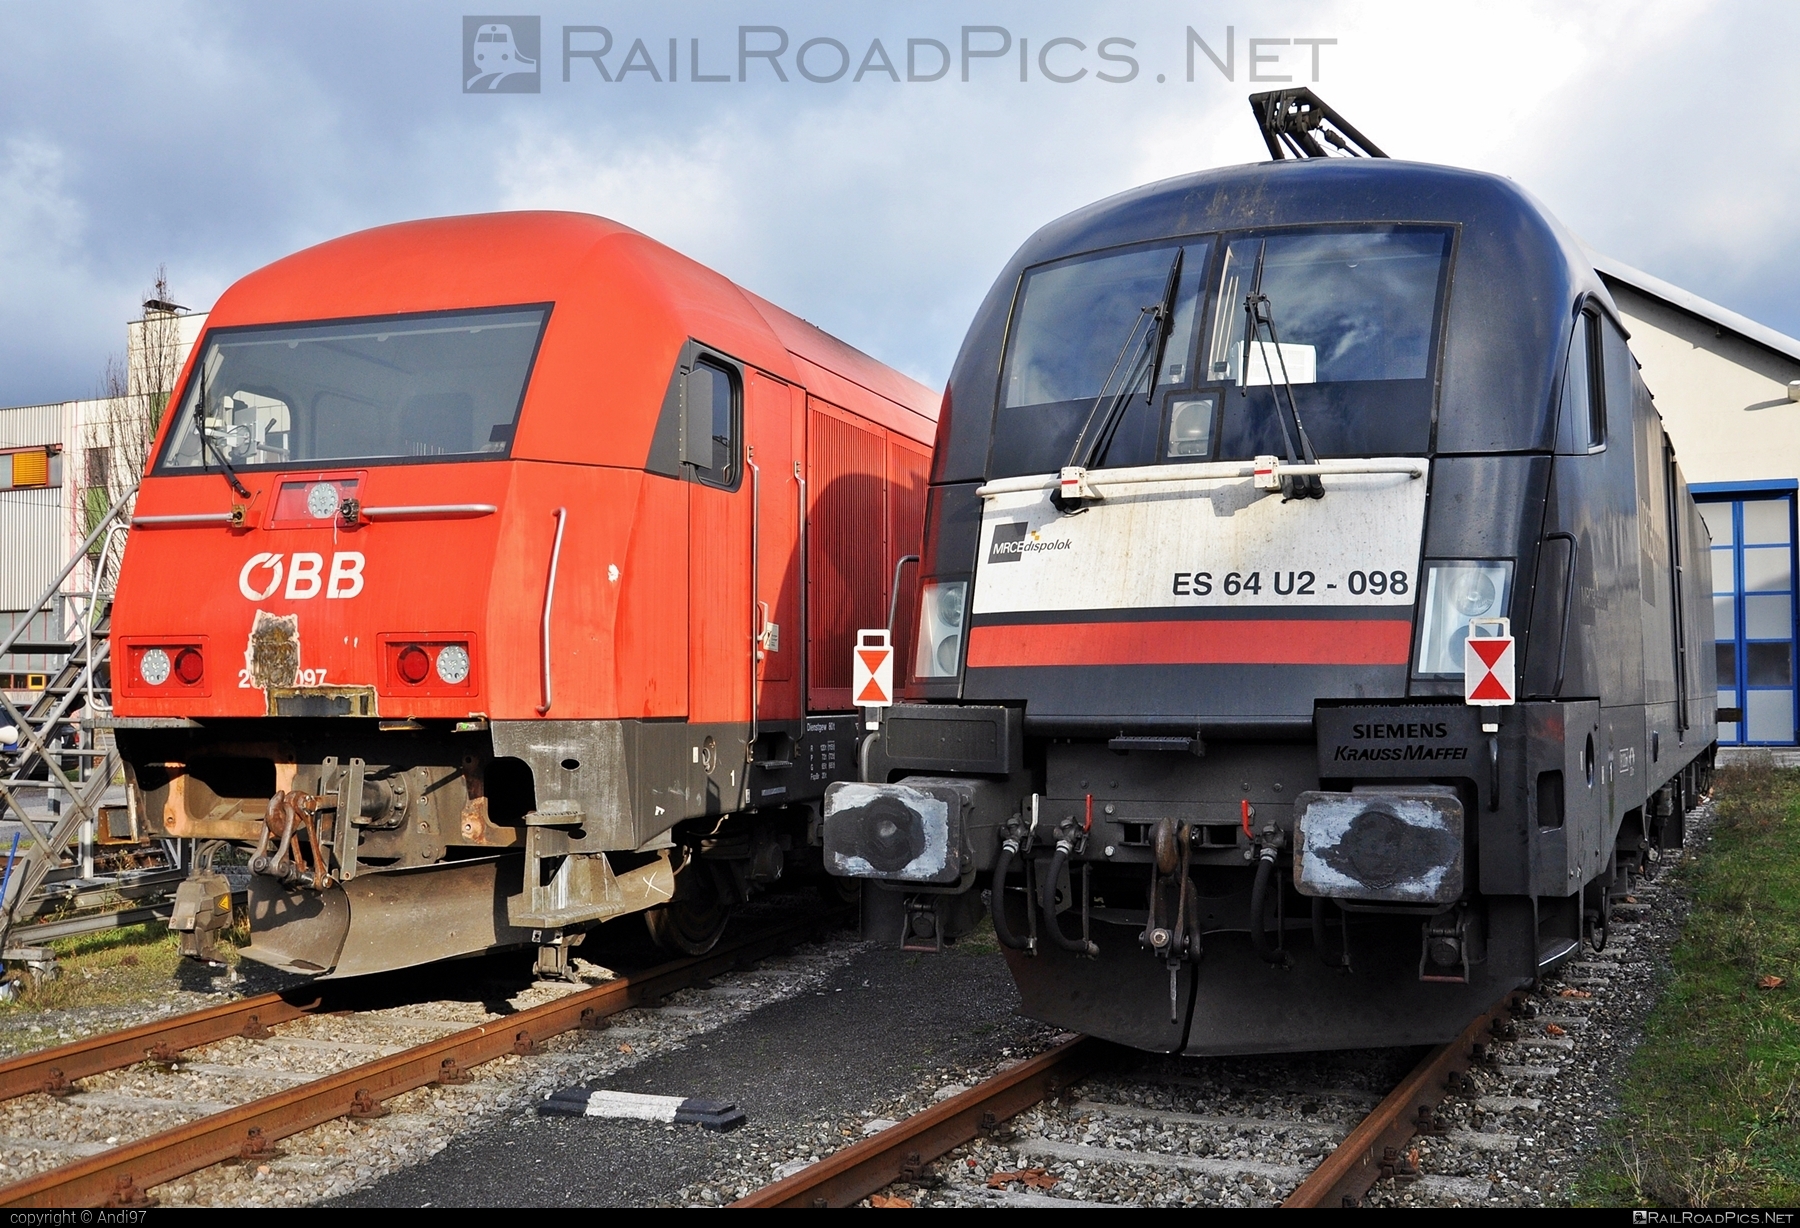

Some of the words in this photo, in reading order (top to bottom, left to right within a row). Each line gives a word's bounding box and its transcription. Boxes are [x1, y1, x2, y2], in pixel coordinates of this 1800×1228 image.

[239, 551, 366, 602] ÖBB
[1172, 571, 1213, 596] ES
[1223, 571, 1262, 596] 64
[1273, 571, 1316, 596] U2
[1347, 570, 1409, 596] 098
[1352, 723, 1448, 739] SIEMENS
